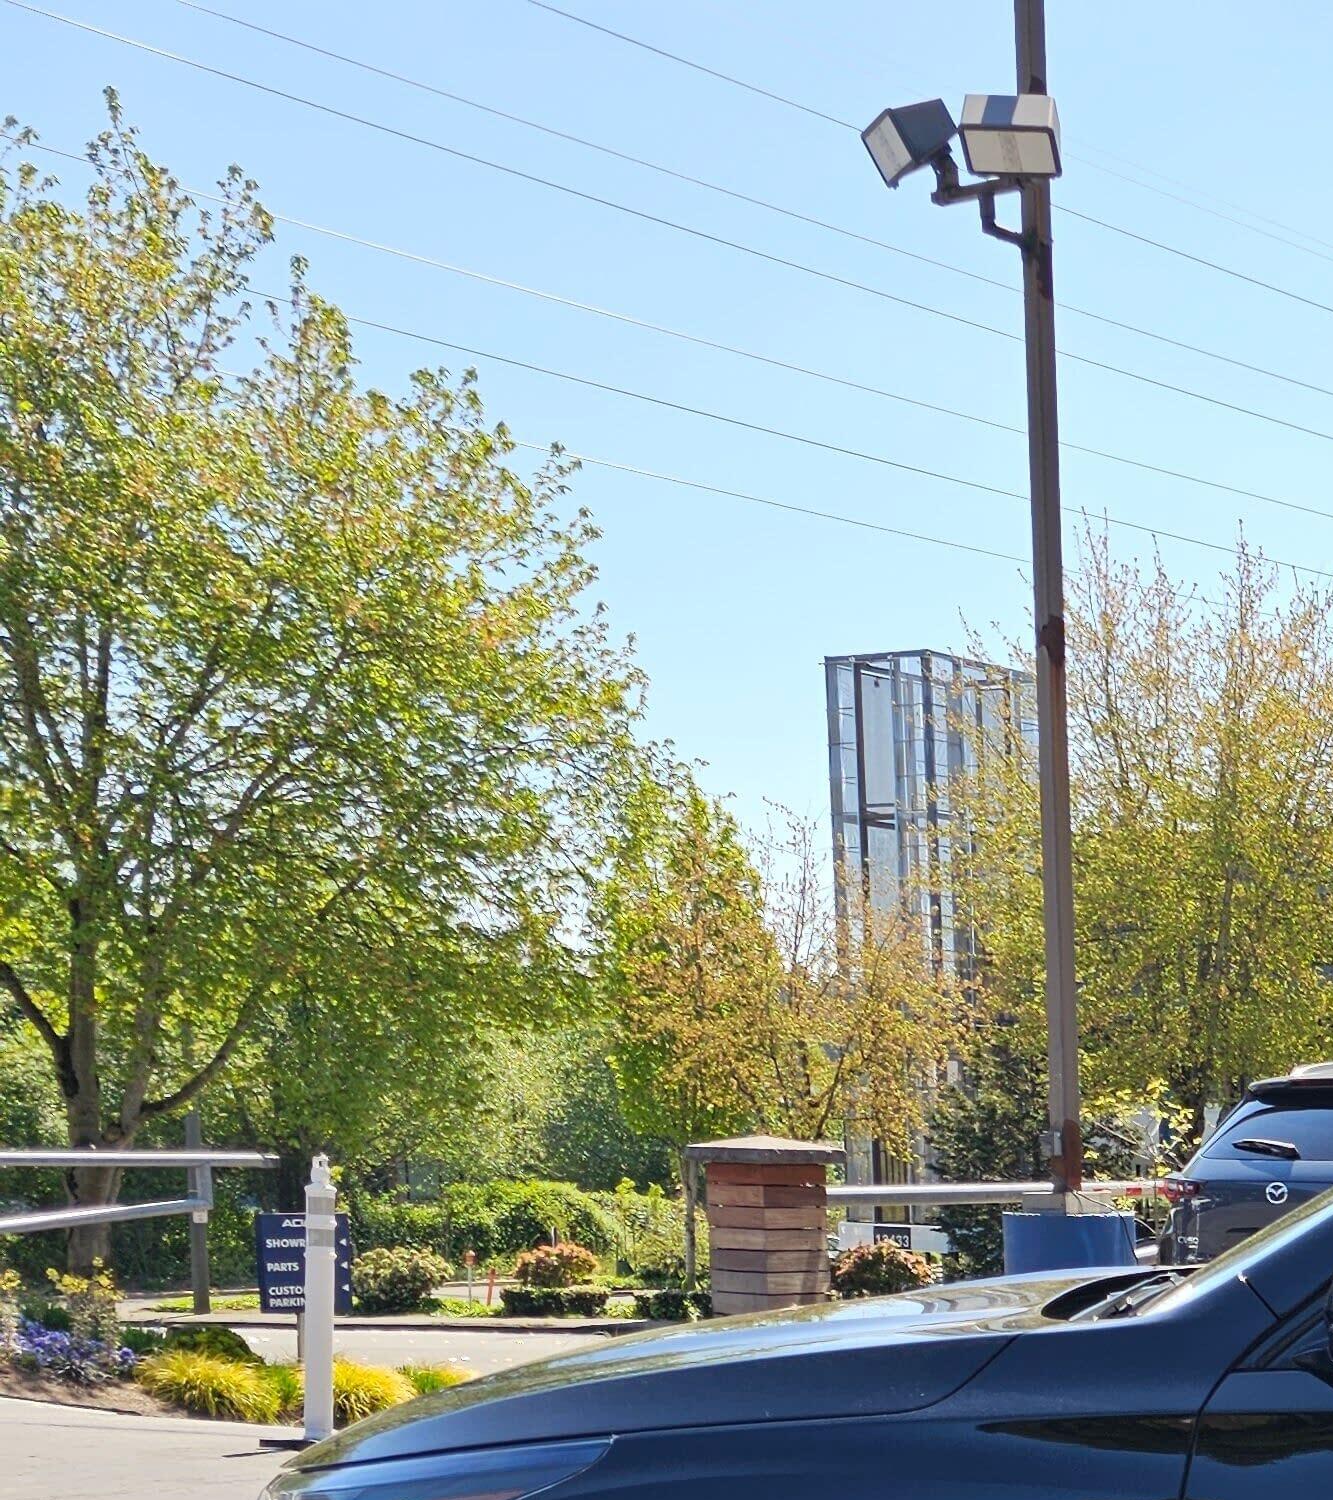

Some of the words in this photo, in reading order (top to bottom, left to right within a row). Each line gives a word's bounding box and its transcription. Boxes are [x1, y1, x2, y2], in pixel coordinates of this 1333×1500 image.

[265, 1238, 306, 1248] SHOWR
[266, 1262, 300, 1272] PARTS
[268, 1285, 304, 1296] CUSTO
[269, 1297, 306, 1308] PARKIN
